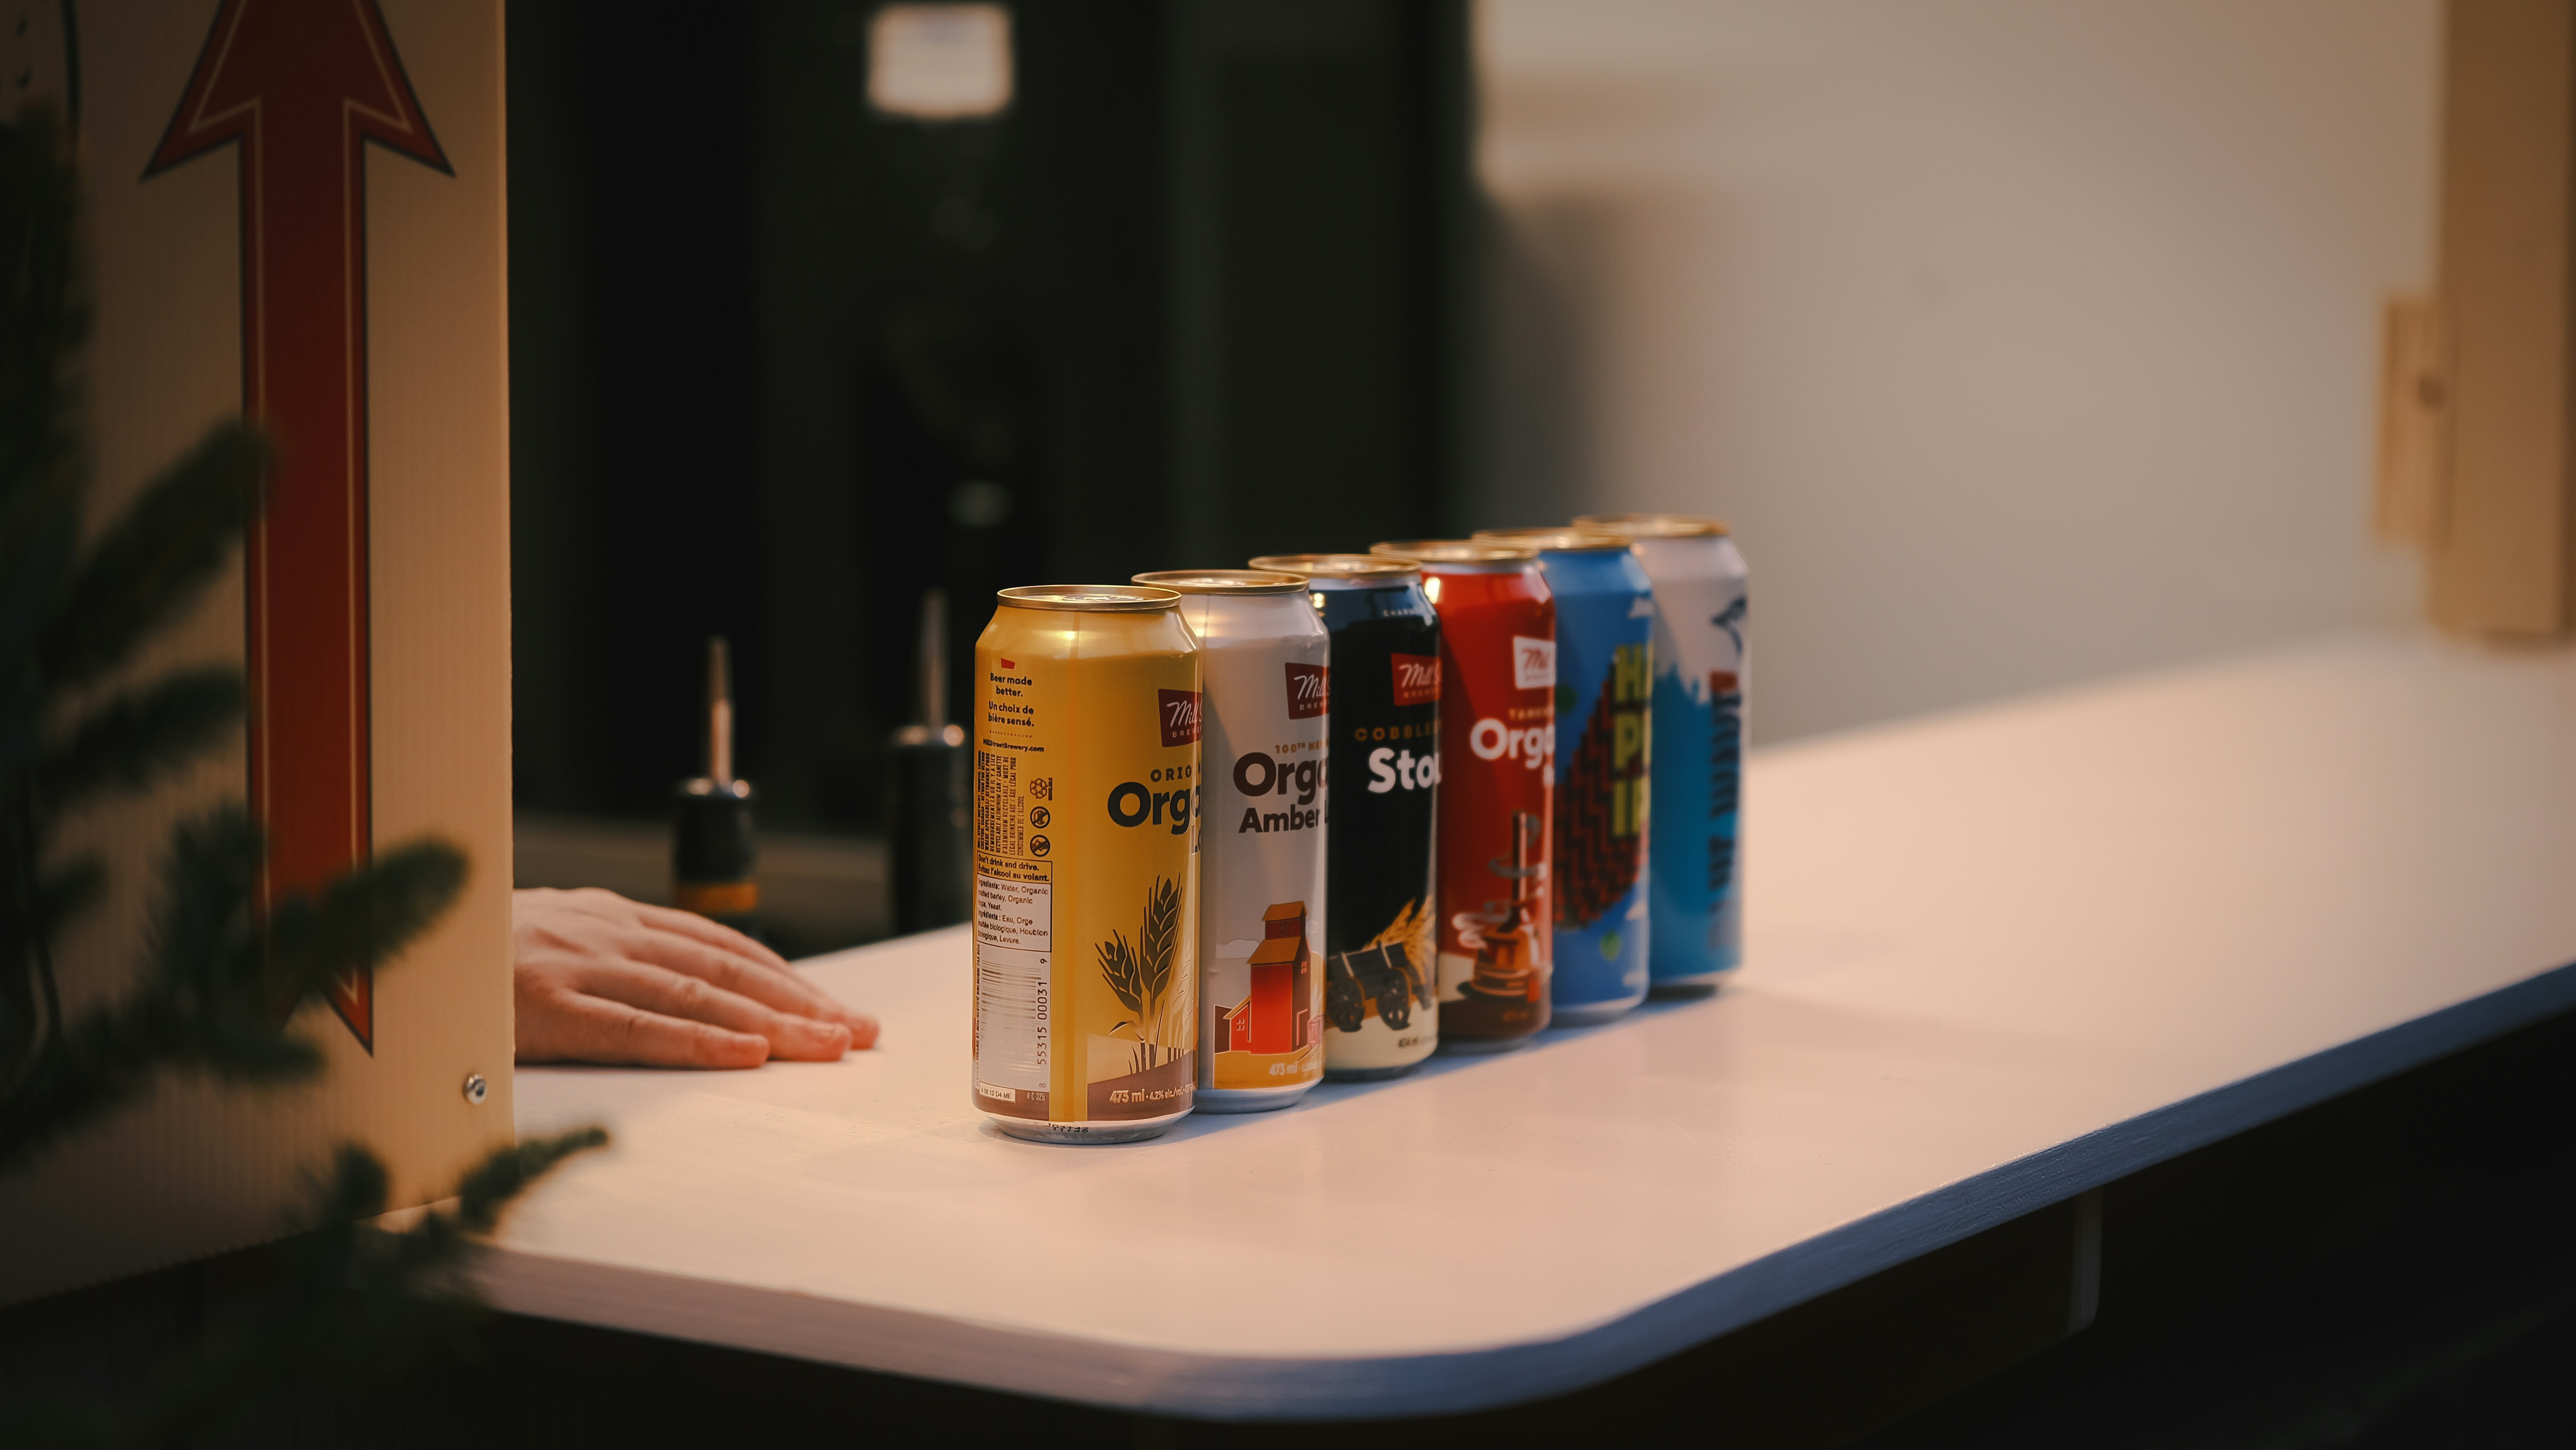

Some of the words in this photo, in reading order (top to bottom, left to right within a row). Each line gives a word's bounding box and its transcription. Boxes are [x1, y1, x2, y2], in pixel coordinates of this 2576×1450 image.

[990, 673, 1006, 683] Beer
[1007, 676, 1032, 685] made
[996, 685, 1023, 697] better.
[989, 701, 997, 710] Un
[999, 703, 1020, 713] choix
[1023, 705, 1034, 715] de
[1166, 700, 1199, 728] Mill
[988, 712, 1005, 723] bière
[1007, 718, 1034, 727] sensé.
[1239, 804, 1321, 834] Amber
[979, 854, 989, 864] Don't
[990, 858, 1003, 867] drink
[991, 867, 1011, 878] l'alcool
[1023, 873, 1049, 882] volant.
[1001, 884, 1019, 893] Water,
[1021, 886, 1048, 895] Organic
[990, 892, 1006, 903] barley,
[1008, 895, 1033, 905] Organic
[988, 902, 1002, 911] Yeast.
[1002, 915, 1015, 924] Eau,
[1017, 917, 1033, 926] Orge
[990, 922, 1018, 934] biologique,
[1020, 927, 1048, 936] Houblon
[999, 935, 1020, 945] Levure.
[1037, 982, 1048, 1020] 00031
[1037, 1027, 1047, 1065] 55315
[1269, 1063, 1285, 1076] 473
[1287, 1061, 1297, 1074] ml
[1109, 1090, 1129, 1104] 473
[1132, 1089, 1145, 1103] ml
